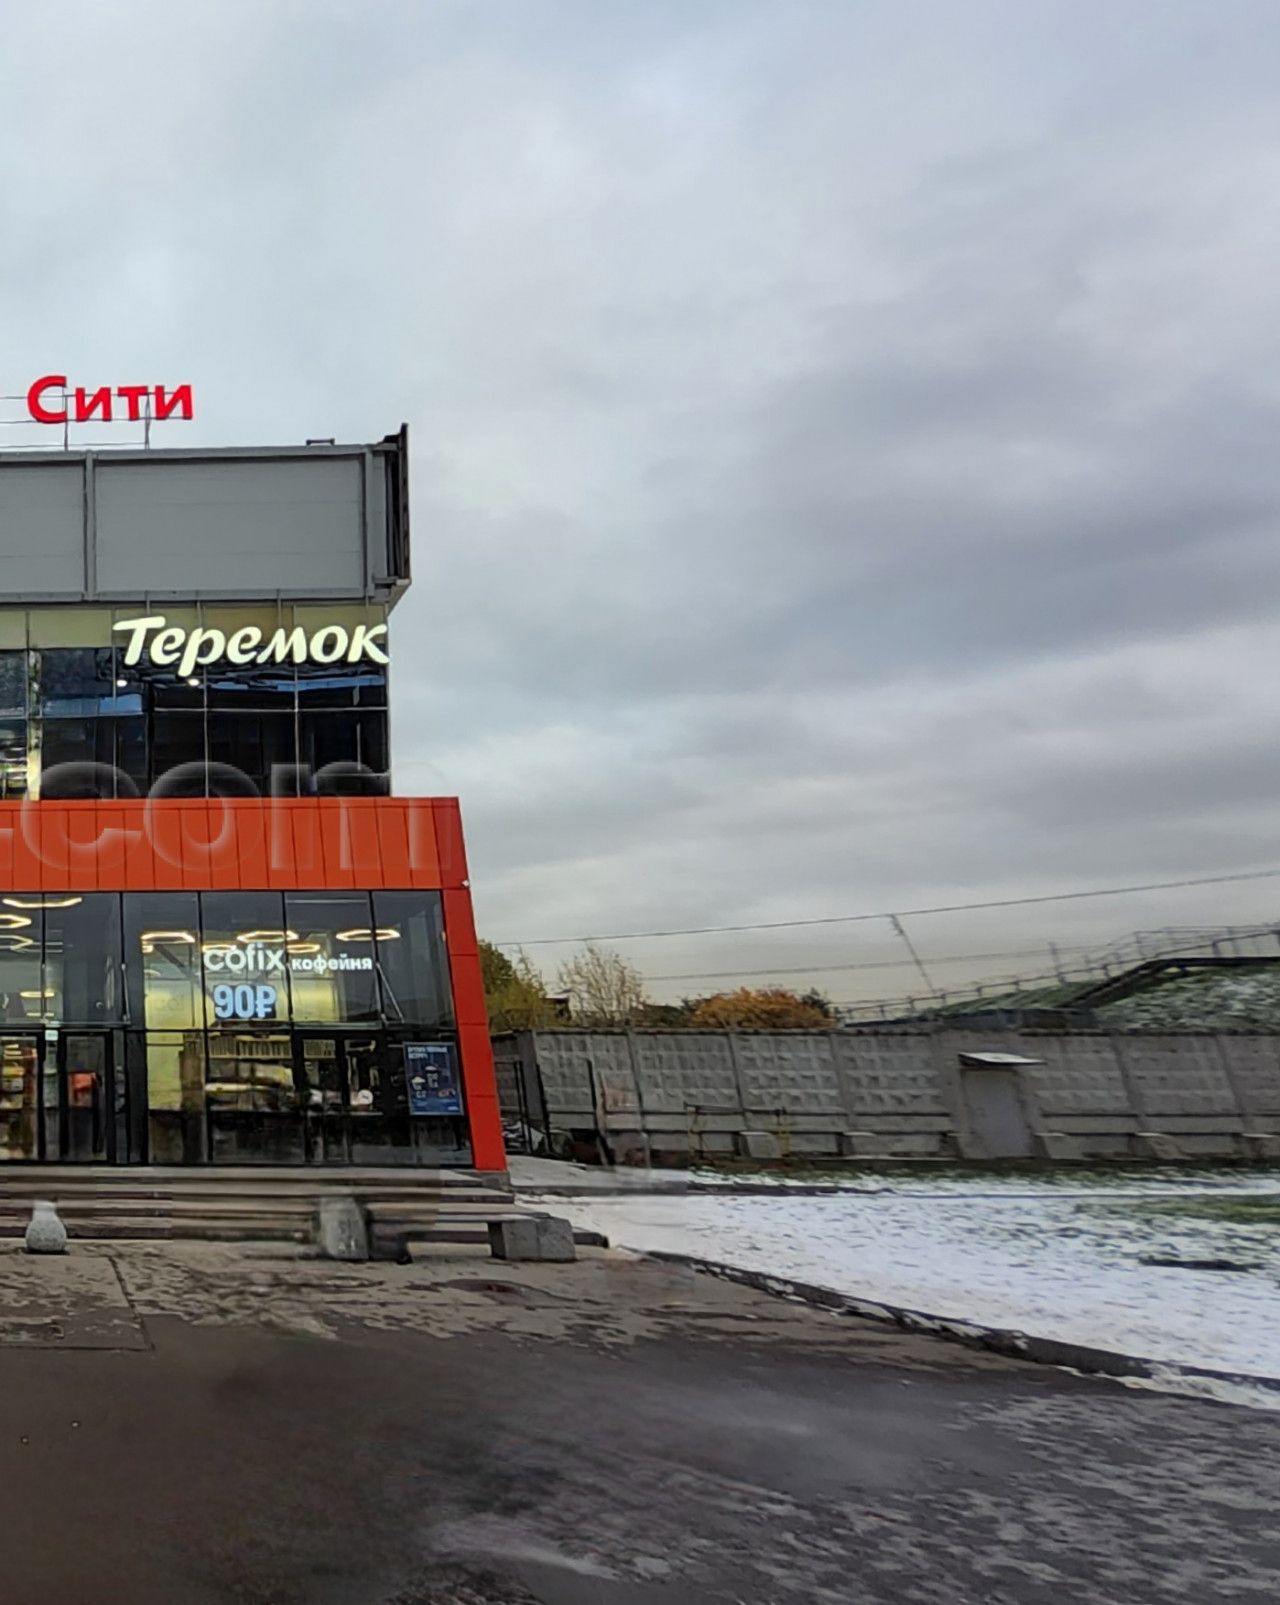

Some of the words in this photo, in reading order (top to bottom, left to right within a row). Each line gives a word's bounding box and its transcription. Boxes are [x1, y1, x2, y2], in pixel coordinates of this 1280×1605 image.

[27, 375, 193, 422] Сити
[112, 616, 390, 677] Теремок
[203, 942, 285, 974] cofix
[291, 953, 373, 975] кофейня
